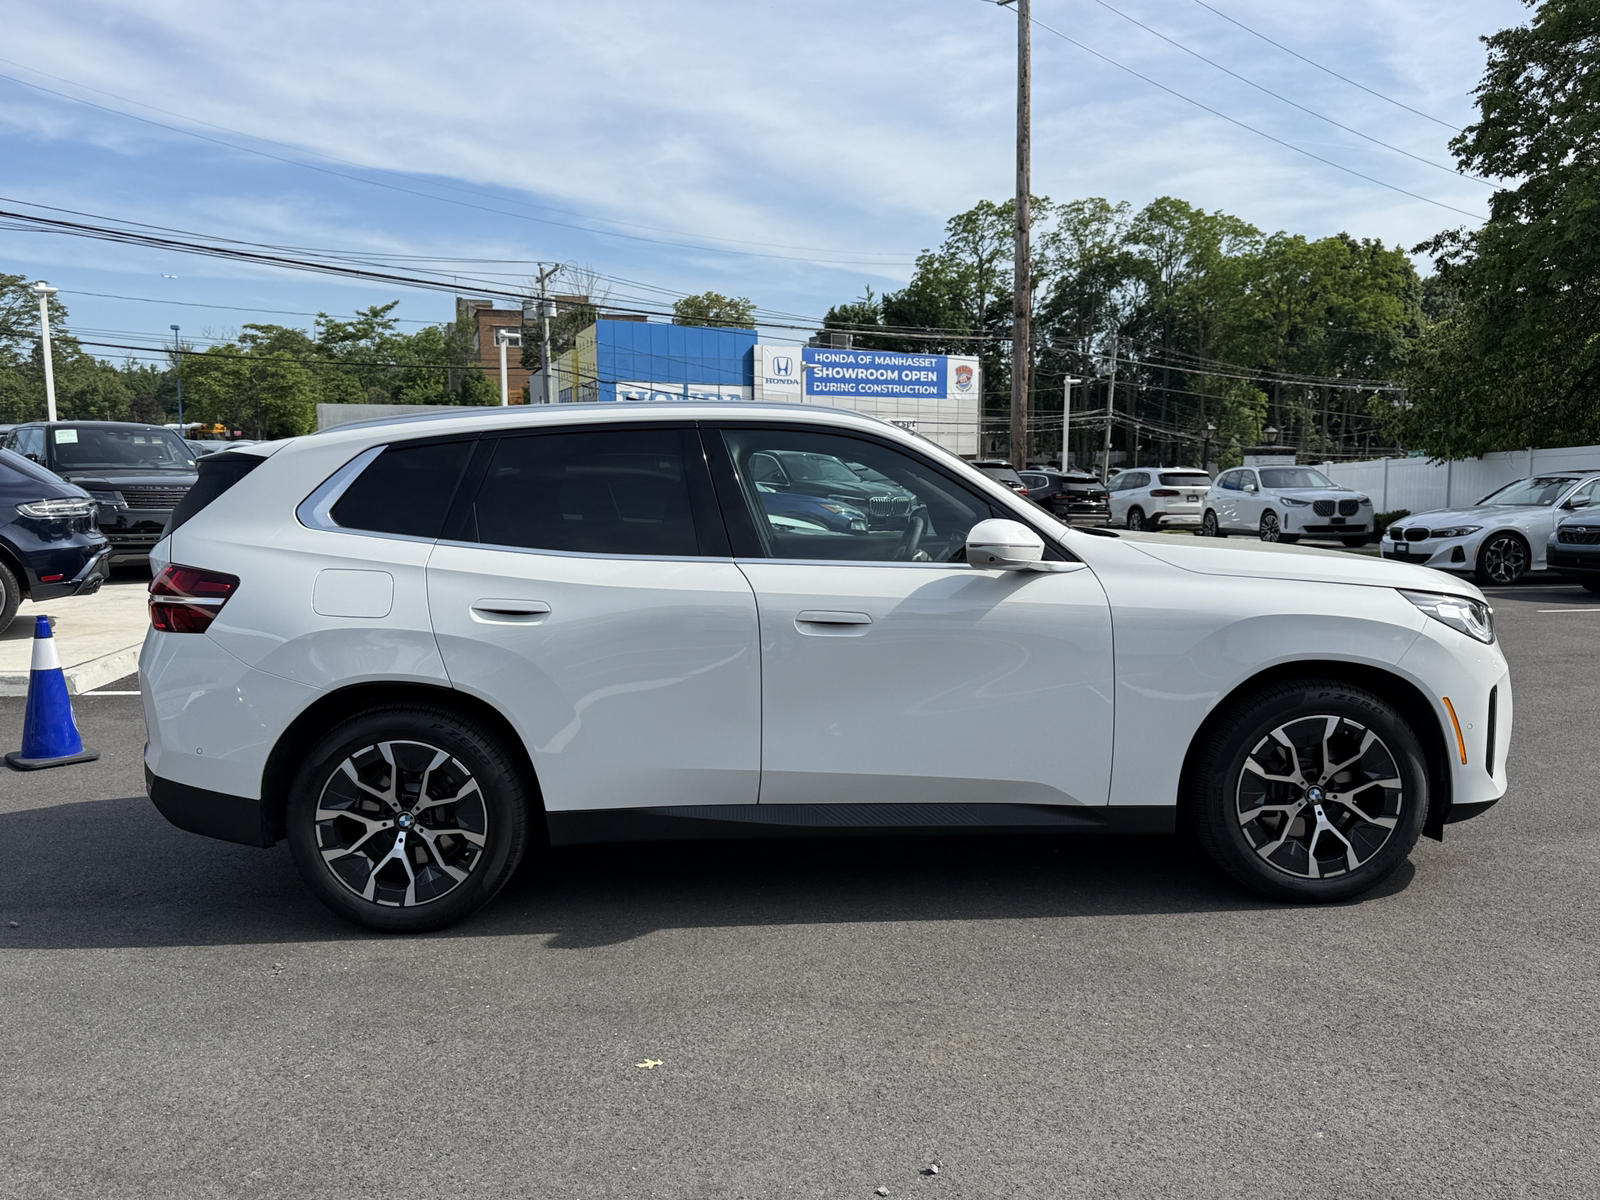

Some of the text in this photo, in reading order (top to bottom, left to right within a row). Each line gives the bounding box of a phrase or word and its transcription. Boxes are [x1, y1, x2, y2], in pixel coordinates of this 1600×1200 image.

[815, 353, 937, 367] HONDA OF MANHASSET
[813, 367, 937, 382] SHOWROOM OPEN
[813, 382, 938, 395] DURING CONSTRUCTION
[1334, 693, 1385, 714] ZERO
